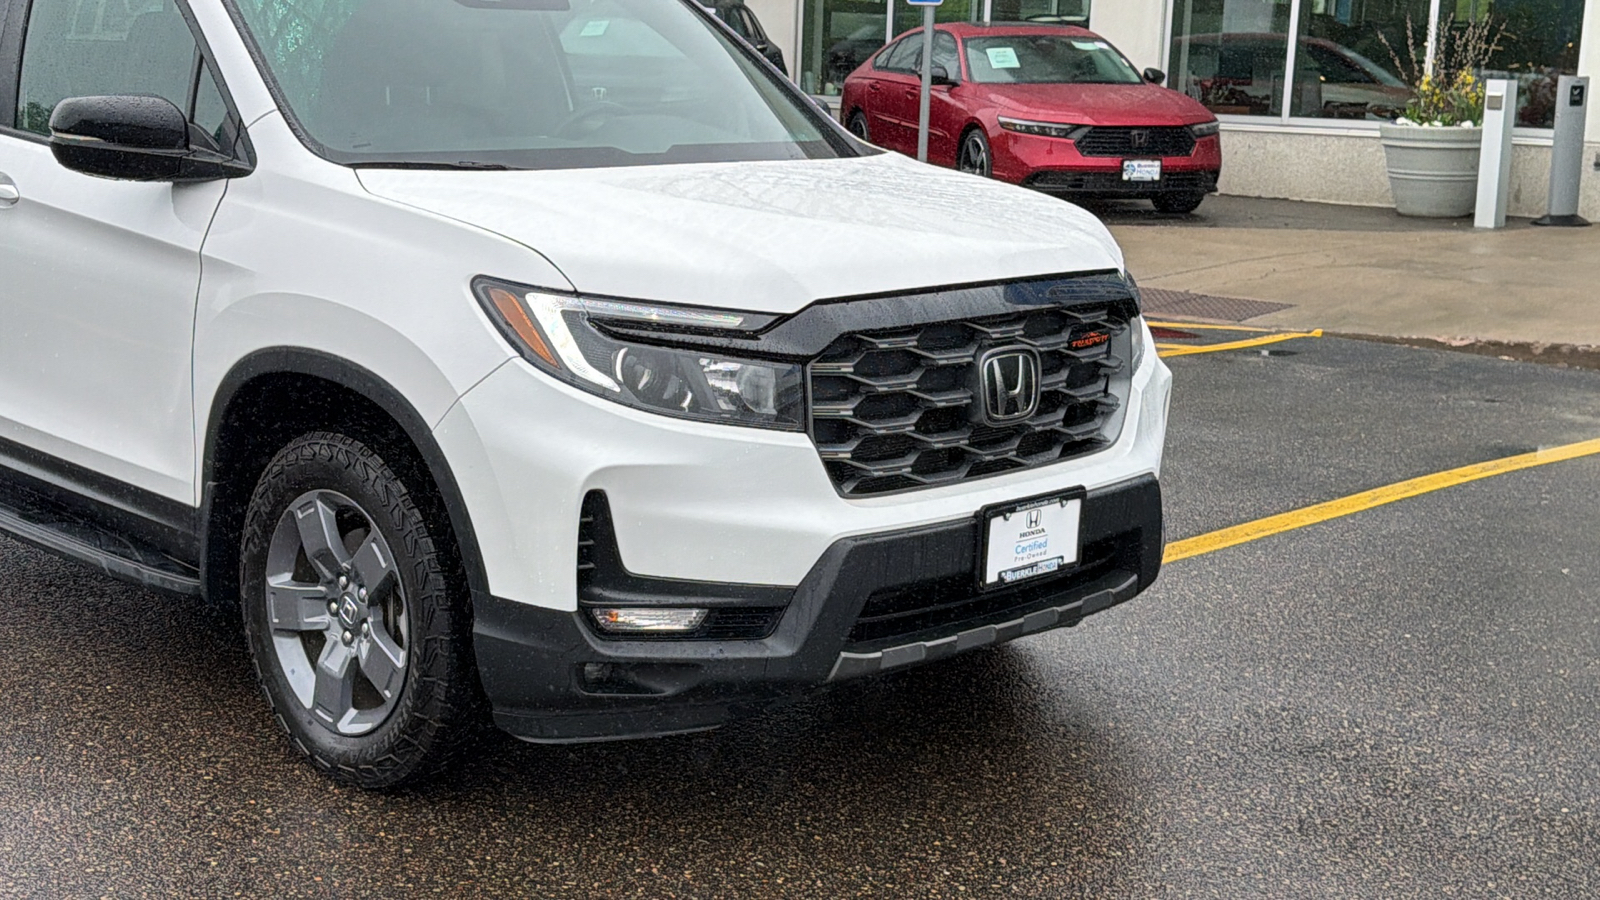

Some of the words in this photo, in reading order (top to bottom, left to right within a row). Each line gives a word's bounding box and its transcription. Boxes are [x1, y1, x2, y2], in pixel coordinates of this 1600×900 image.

[1019, 528, 1046, 538] HONDA
[1015, 538, 1048, 554] Certified
[1014, 550, 1047, 562] Pre-Owned
